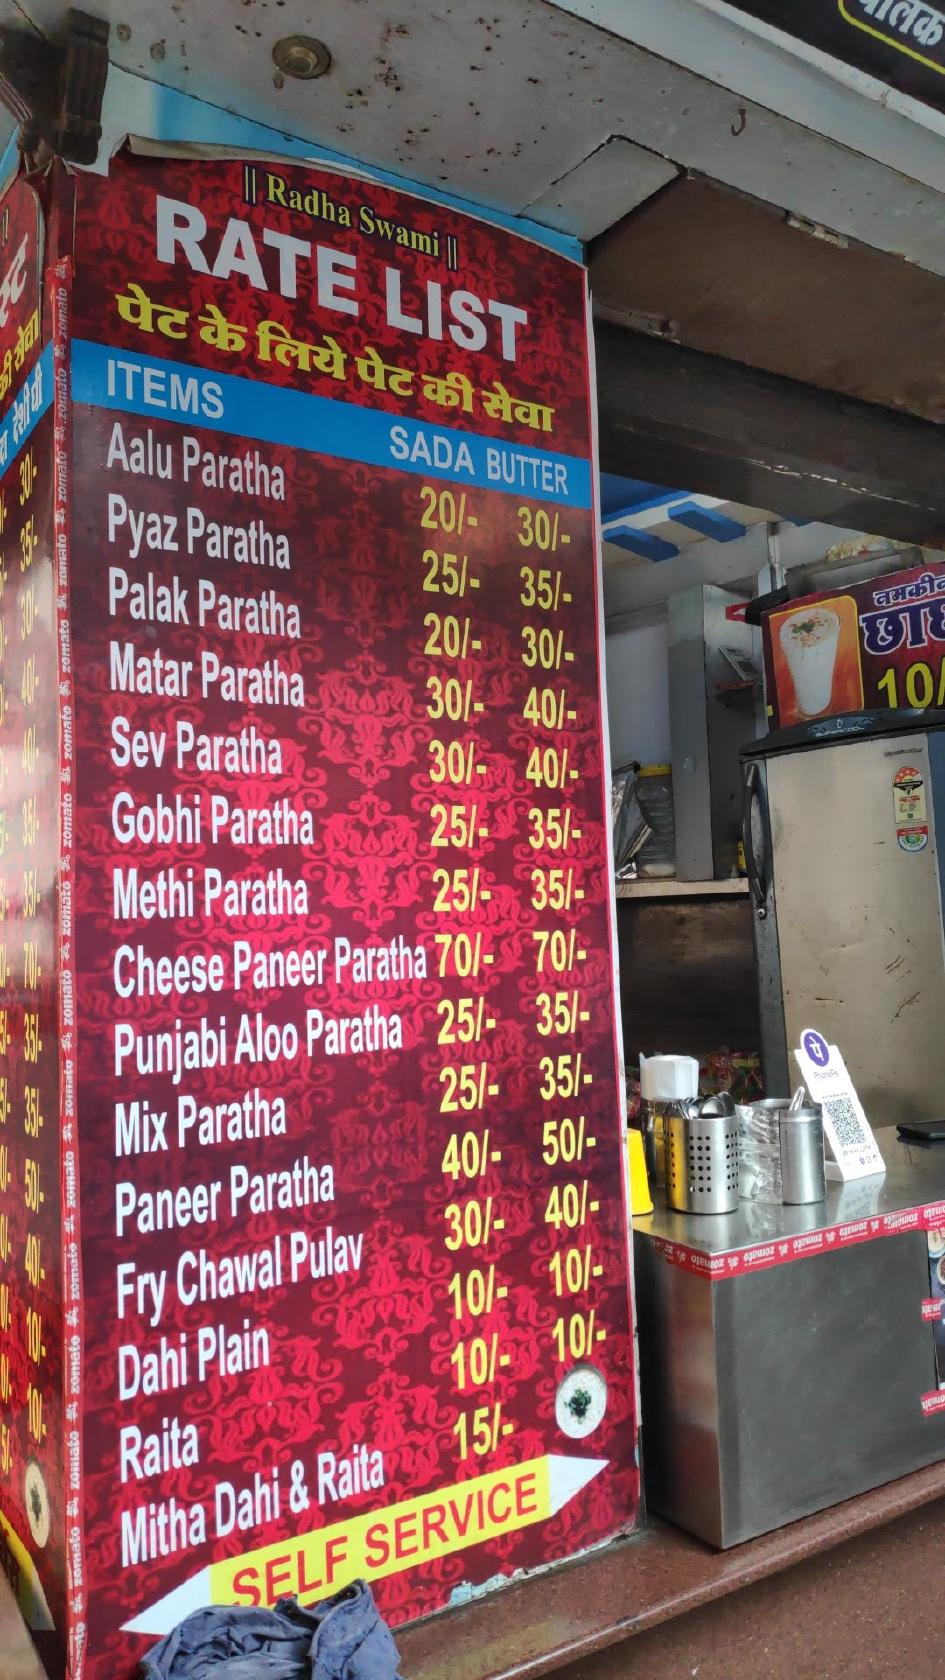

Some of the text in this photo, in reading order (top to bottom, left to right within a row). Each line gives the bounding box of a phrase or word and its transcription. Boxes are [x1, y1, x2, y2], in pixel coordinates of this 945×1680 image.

[266, 173, 352, 228] Radha
[359, 206, 440, 258] Swami
[156, 195, 528, 362] RATE LIST
[56, 287, 68, 339] zomato
[114, 283, 555, 433] पेट के लिये पेट की सेवा
[107, 360, 224, 419] ITEMS
[57, 450, 68, 501] zomato
[106, 422, 286, 500] Aalu Paratha
[389, 426, 569, 496] SADA BUTTER
[108, 493, 291, 569] Pyaz Paratha
[420, 486, 478, 535] 20/-
[517, 506, 571, 551] 30/-
[20, 514, 37, 572] 35/-
[58, 534, 68, 586] zomato
[422, 549, 480, 597] 25/-
[520, 566, 572, 611] 35/-
[109, 566, 301, 639] Palak Paratha
[61, 619, 70, 673] zomato
[423, 612, 482, 659] 20/-
[521, 626, 574, 670] 30/-
[110, 641, 305, 707] Matar Paratha
[426, 676, 484, 722] 30/-
[63, 705, 72, 760] zomato
[523, 686, 577, 730] 40/-
[110, 716, 282, 774] Sev Paratha
[428, 739, 486, 785] 30/-
[526, 746, 579, 789] 40/-
[63, 792, 72, 848] zomato
[112, 792, 314, 845] Gobhi Paratha
[430, 803, 488, 848] 25/-
[528, 807, 581, 849] 35/-
[62, 881, 72, 936] zomato
[113, 868, 308, 919] Methi Paratha
[432, 867, 491, 912] 25/-
[531, 868, 585, 910] 35/-
[114, 934, 427, 998] Cheese Paneer Paratha
[434, 931, 494, 977] 70/-
[532, 928, 587, 972] 70/-
[63, 969, 74, 1026] zomato
[437, 996, 496, 1045] 25/-
[535, 990, 590, 1036] 35/-
[25, 1013, 42, 1063] 35/-
[115, 1004, 403, 1085] Punjabi Aloo Paratha
[64, 1059, 74, 1117] zomato
[439, 1061, 499, 1113] 25/-
[539, 1053, 593, 1101] 35/-
[25, 1086, 43, 1138] 35/-
[115, 1088, 287, 1157] Mix Paratha
[441, 1129, 502, 1180] 40/-
[542, 1115, 596, 1165] 50/-
[25, 1159, 44, 1214] 50/-
[65, 1151, 77, 1208] zomato
[116, 1155, 335, 1237] Paneer Paratha
[545, 1179, 600, 1229] 40/-
[444, 1196, 505, 1250] 30/-
[839, 1220, 868, 1237] zomato
[923, 1201, 945, 1220] omato
[25, 1232, 45, 1288] 40/-
[690, 1254, 725, 1270] zomato
[743, 1245, 775, 1263] zomato
[793, 1233, 823, 1249] zomato
[68, 1242, 80, 1300] zomato
[117, 1226, 363, 1327] Fry Chawal Pulav
[448, 1264, 508, 1320] 10/-
[549, 1244, 603, 1296] 10/-
[27, 1306, 46, 1367] 10/-
[118, 1319, 270, 1401] Dahi Plain
[451, 1332, 510, 1389] 10/-
[552, 1309, 606, 1362] 10/-
[70, 1335, 80, 1394] zomato
[28, 1382, 46, 1444] 10/-
[453, 1402, 513, 1460] 15/-
[70, 1430, 80, 1490] zomato
[120, 1418, 199, 1484] Raita
[121, 1444, 384, 1568] Mitha Dahi & Raita
[70, 1526, 83, 1586] zomato
[232, 1473, 538, 1607] SELF SERVICE
